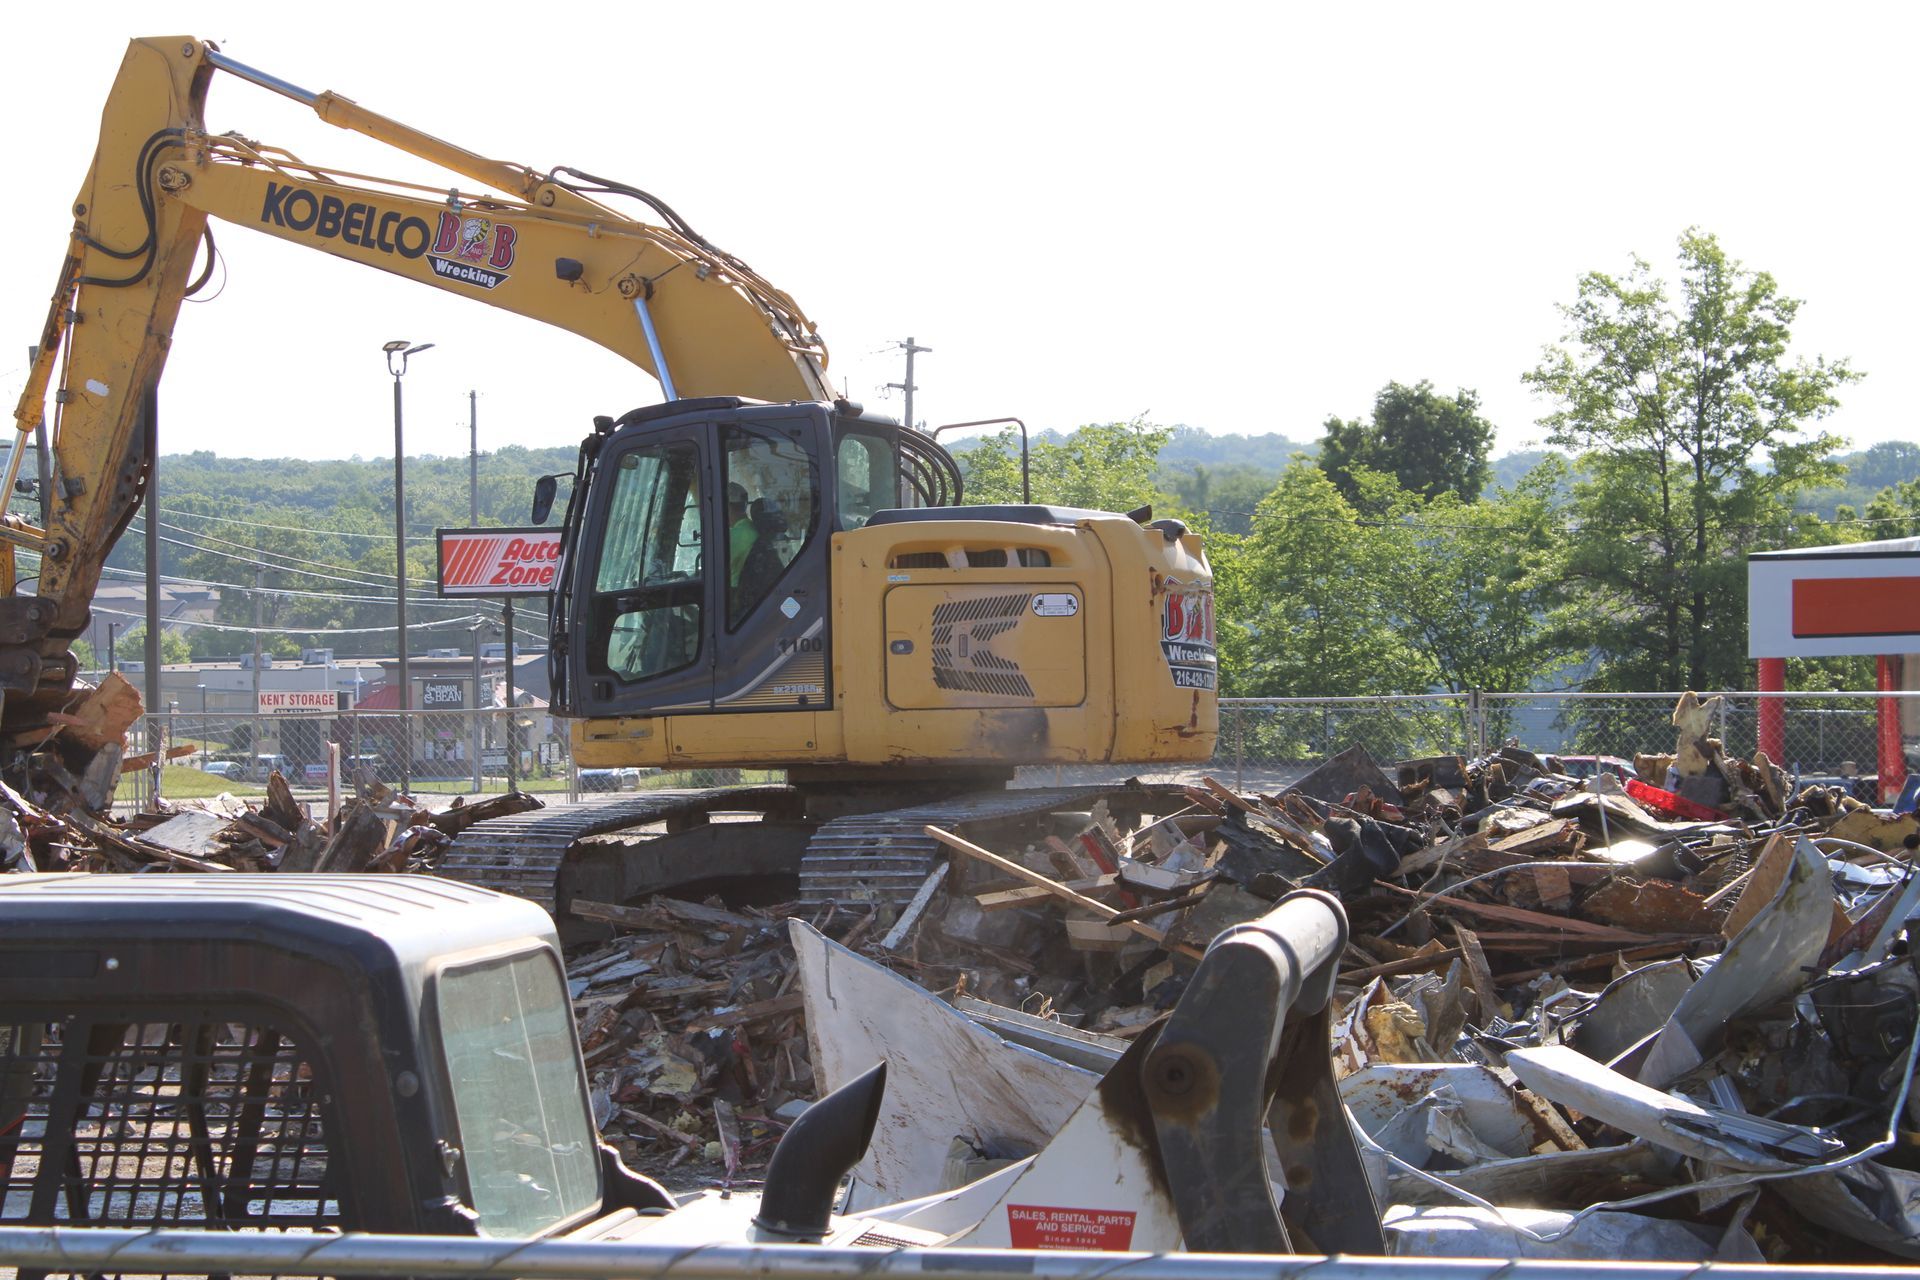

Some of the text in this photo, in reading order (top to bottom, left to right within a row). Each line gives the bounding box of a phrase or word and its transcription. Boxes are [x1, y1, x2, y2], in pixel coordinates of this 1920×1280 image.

[261, 181, 431, 259] KOBELCO
[435, 212, 461, 253] B
[489, 225, 517, 268] B
[436, 258, 496, 288] Wrecking
[502, 538, 561, 561] Auto
[489, 562, 555, 585] Zone
[260, 694, 335, 706] KENT STORAGE
[435, 691, 462, 702] BEAN
[1012, 1210, 1131, 1226] SALES, RENTAL, PARTS
[1036, 1222, 1106, 1235] AND SERVICE
